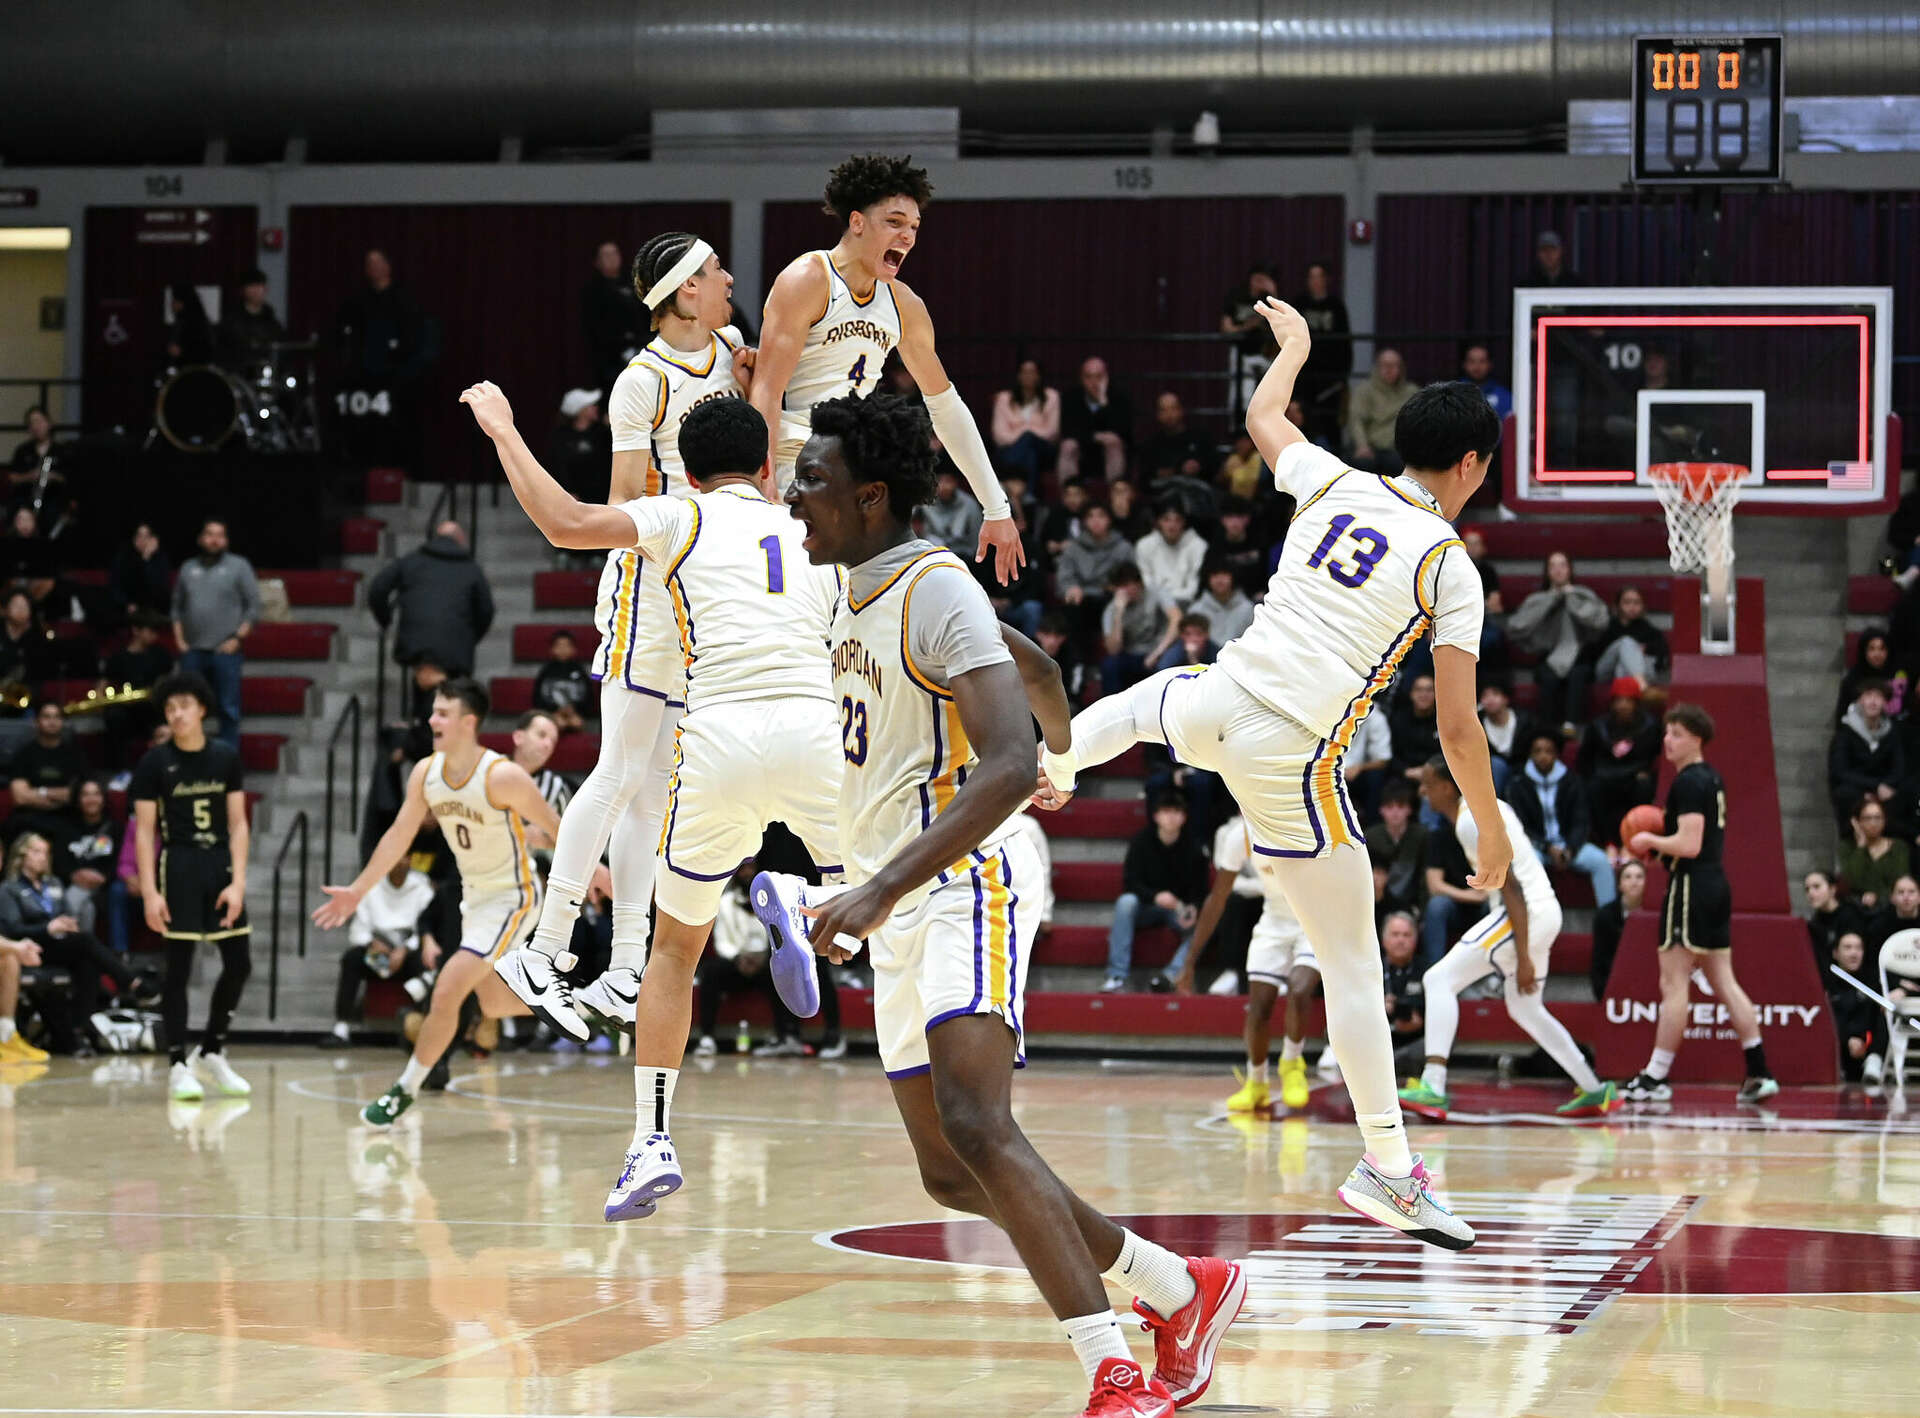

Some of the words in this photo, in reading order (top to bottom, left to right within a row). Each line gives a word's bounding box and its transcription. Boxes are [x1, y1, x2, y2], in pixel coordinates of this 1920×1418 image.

[145, 175, 182, 197] 104
[1115, 165, 1154, 190] 105
[822, 319, 891, 353] RIORDAN
[847, 352, 868, 389] 4
[336, 390, 391, 416] 104
[758, 535, 785, 595] 1
[1305, 513, 1390, 588] 13
[831, 638, 883, 700] RIORDAN
[842, 693, 869, 768] 23
[193, 798, 211, 831] 5
[456, 823, 472, 850] 0
[1606, 997, 1820, 1027] UNERITY
